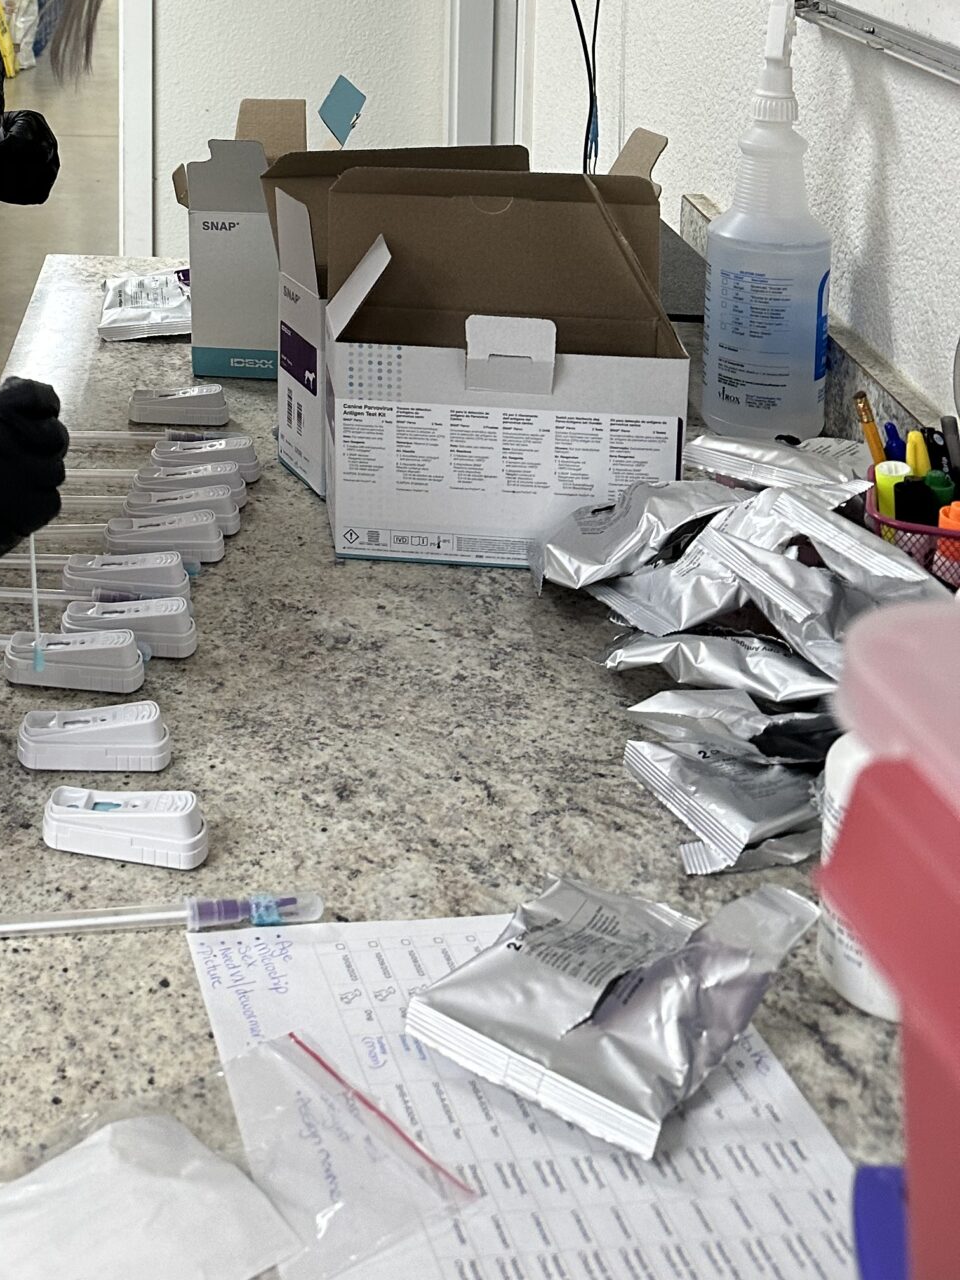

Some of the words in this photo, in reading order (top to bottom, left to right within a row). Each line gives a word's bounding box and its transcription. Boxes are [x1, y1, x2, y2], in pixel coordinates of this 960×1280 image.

[230, 358, 273, 369] IDEXX
[239, 946, 256, 969] Sex
[277, 939, 294, 962] Age
